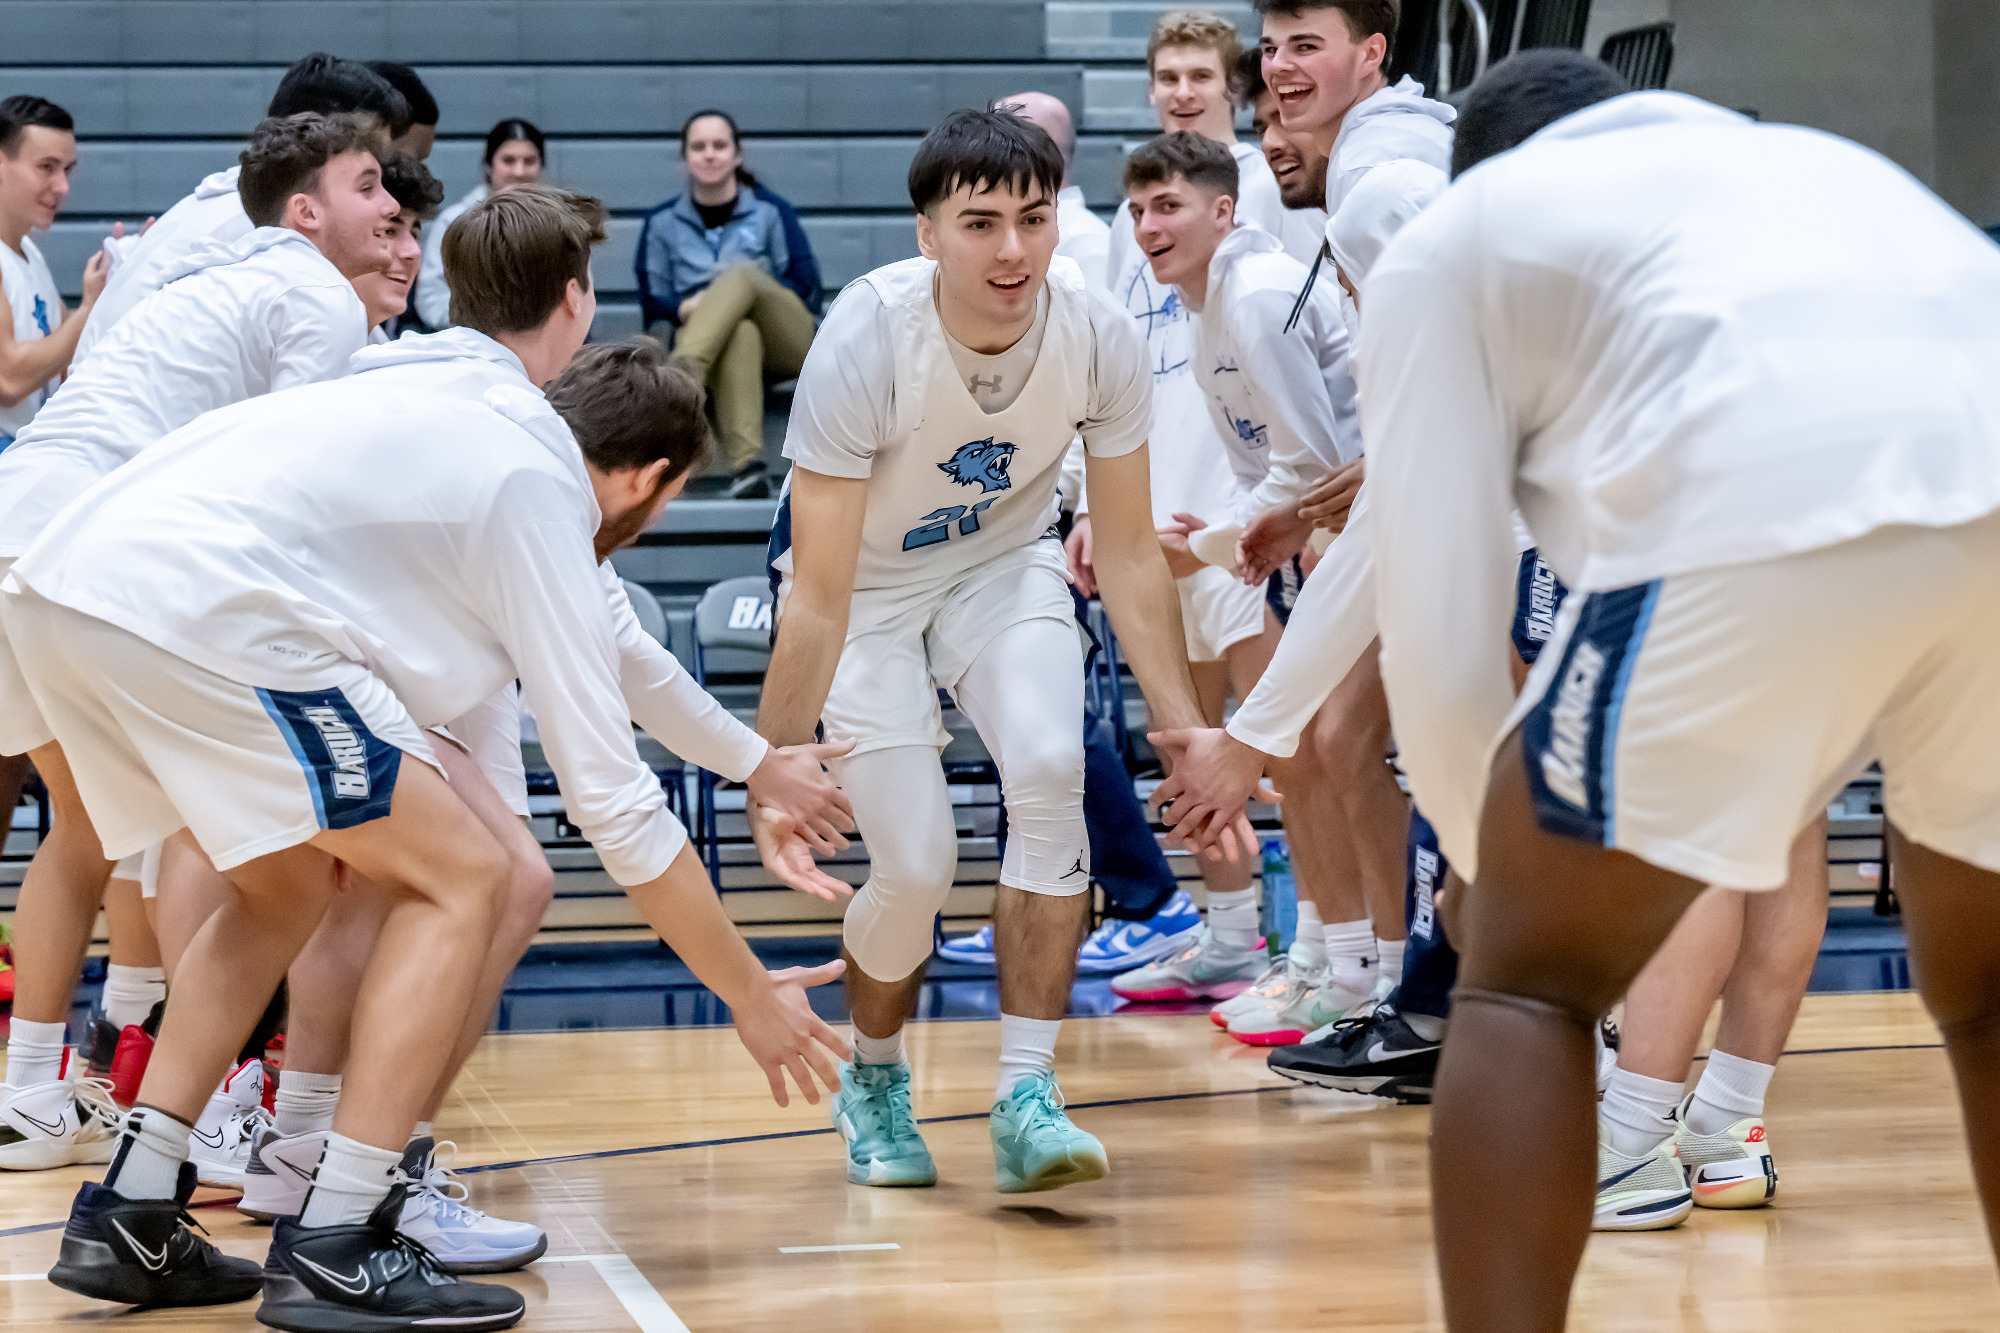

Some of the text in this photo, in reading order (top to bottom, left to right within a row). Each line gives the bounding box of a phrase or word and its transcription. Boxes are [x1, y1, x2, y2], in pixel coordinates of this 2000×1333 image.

[902, 496, 1000, 552] 21
[301, 706, 371, 799] BARUCH
[1411, 845, 1438, 940] BARUCH
